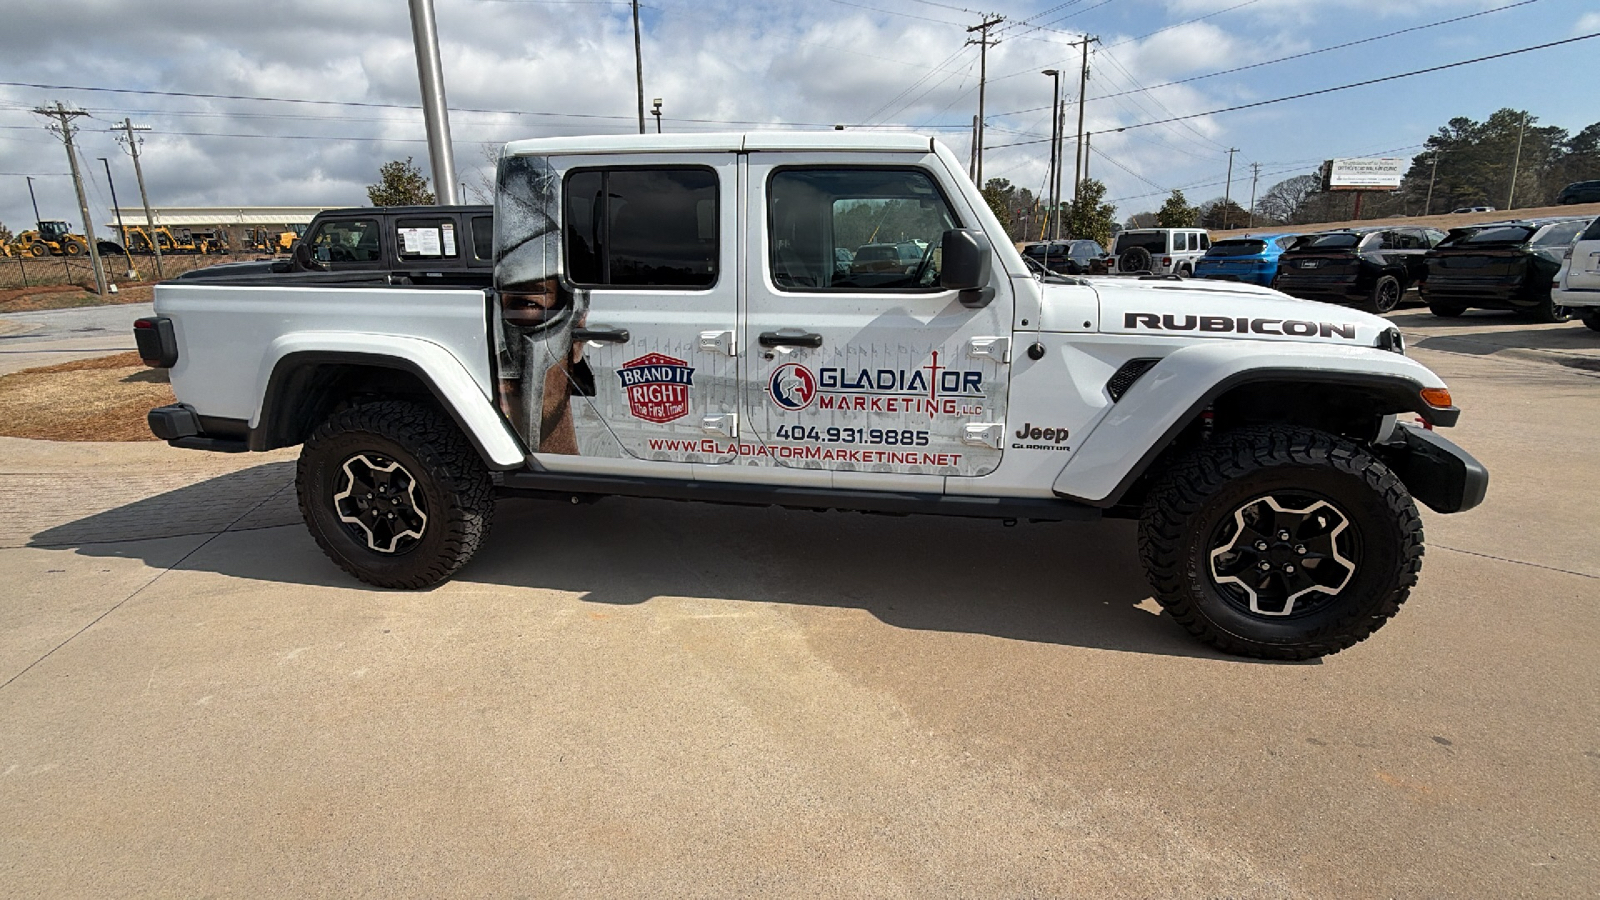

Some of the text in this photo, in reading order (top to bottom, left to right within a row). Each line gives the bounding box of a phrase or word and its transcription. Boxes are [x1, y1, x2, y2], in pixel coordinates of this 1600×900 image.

[1124, 312, 1356, 340] RUBICON
[622, 367, 691, 384] BRAND IT
[819, 360, 983, 393] GLADIATOR
[632, 385, 684, 402] RIGHT
[634, 402, 648, 416] The
[648, 403, 665, 418] First
[962, 405, 983, 416] LLC
[776, 424, 930, 447] 404.931.9885
[1015, 422, 1069, 444] Jeep
[1011, 443, 1071, 452] GLADIATOR
